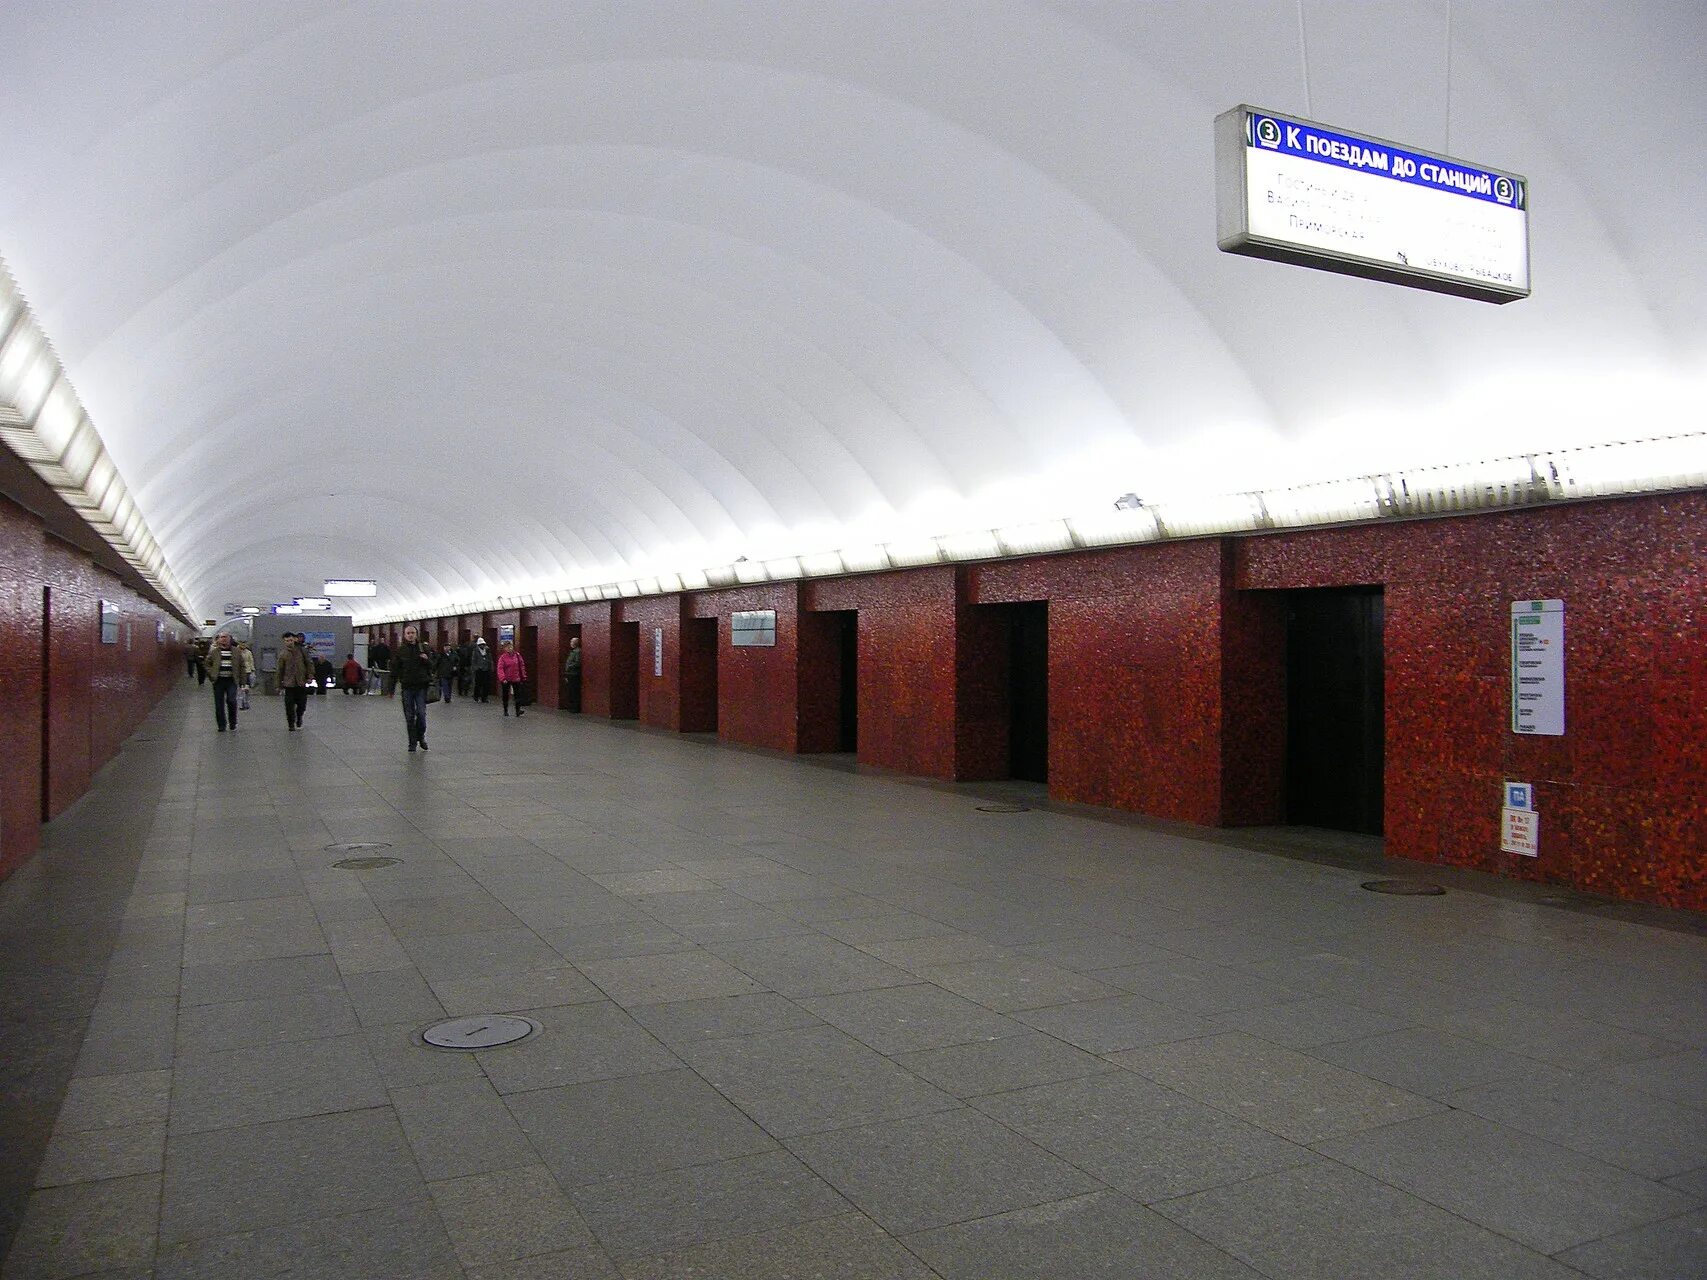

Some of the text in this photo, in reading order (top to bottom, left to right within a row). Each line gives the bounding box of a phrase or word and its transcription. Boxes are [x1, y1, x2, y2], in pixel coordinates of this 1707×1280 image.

[1287, 126, 1303, 150] К
[1306, 135, 1389, 171] ПОЕЗДАМ
[1392, 156, 1417, 178] ДО
[1420, 164, 1492, 196] СТАНЦИЙ
